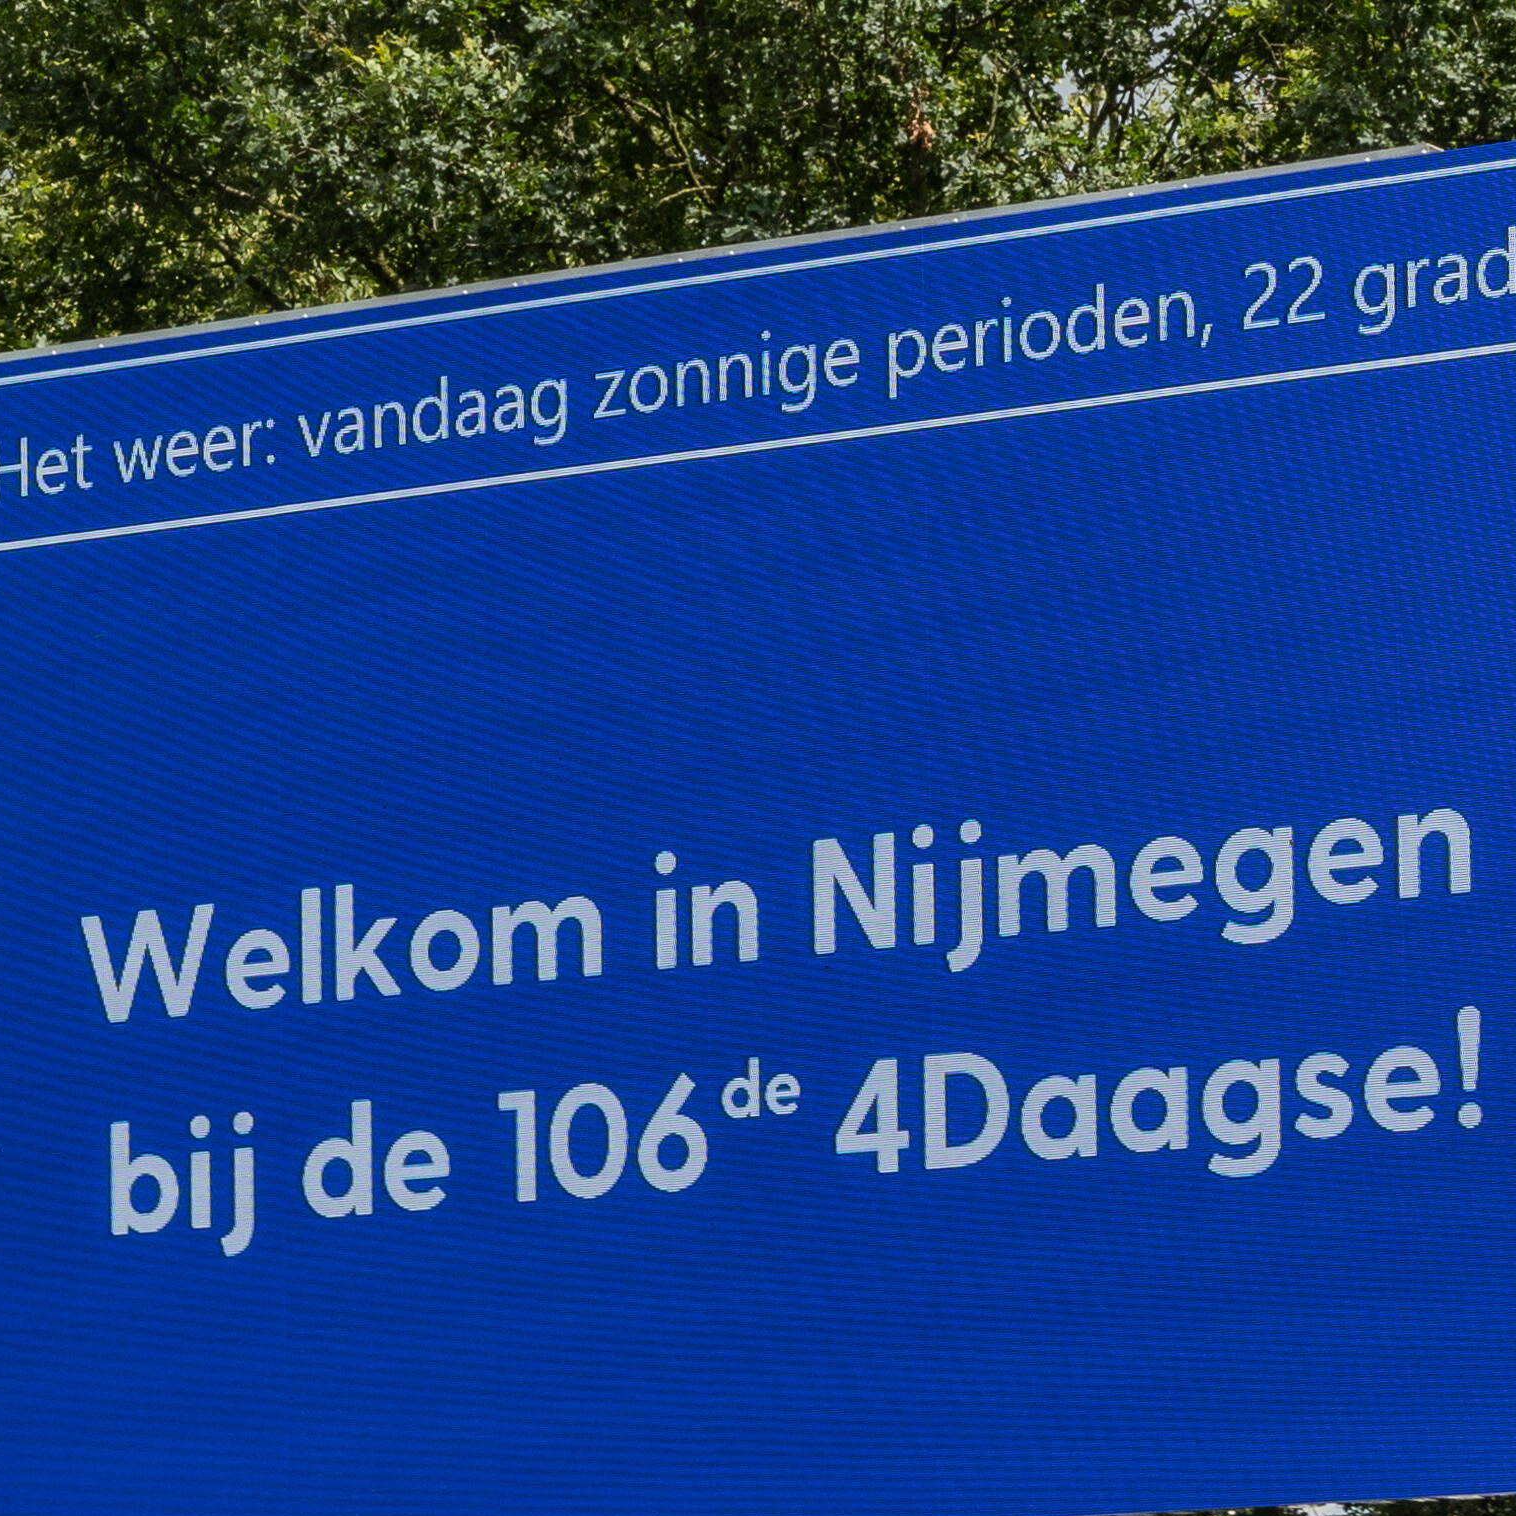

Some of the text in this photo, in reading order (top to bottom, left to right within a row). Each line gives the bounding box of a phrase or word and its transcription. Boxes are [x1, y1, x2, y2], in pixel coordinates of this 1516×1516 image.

[113, 417, 277, 485] weer:
[298, 376, 568, 458] vandaag
[593, 329, 861, 421] zonnige
[887, 283, 1213, 399] perioden,
[1243, 256, 1326, 331] 22
[80, 807, 1472, 1023] Welkom in Nijmegen
[109, 1110, 256, 1258] bij
[302, 1098, 451, 1219] de
[835, 1004, 1483, 1179] 4Daagse!
